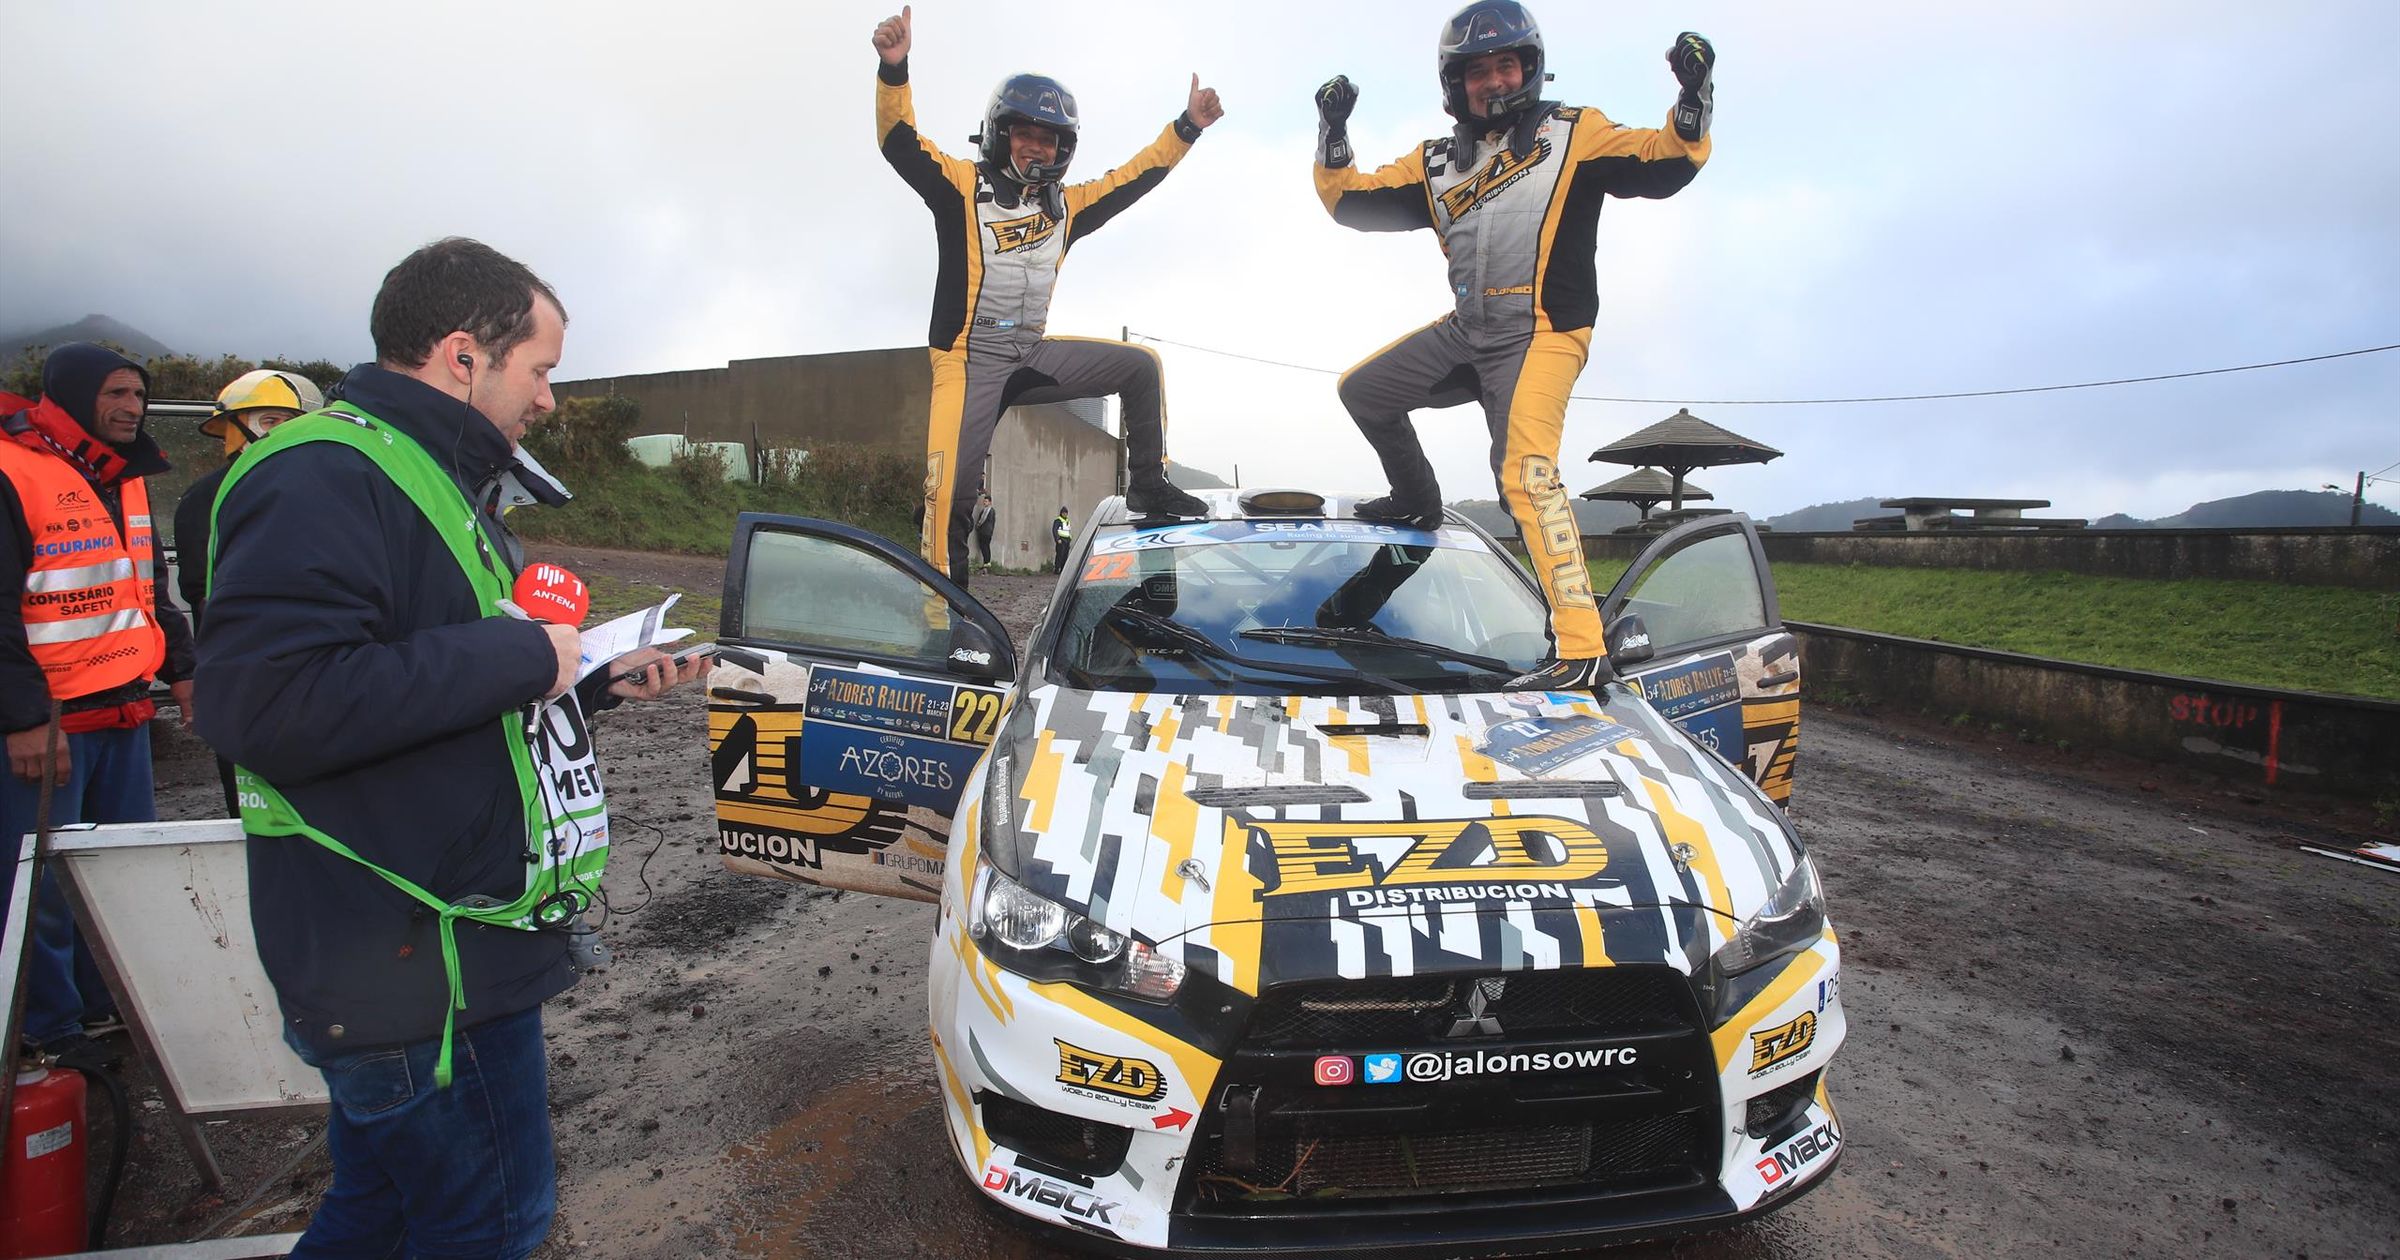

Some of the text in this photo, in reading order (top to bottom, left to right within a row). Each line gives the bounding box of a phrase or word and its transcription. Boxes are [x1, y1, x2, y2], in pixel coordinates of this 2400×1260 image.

[1468, 168, 1530, 213] DISTRIBUCION
[976, 318, 996, 326] OMP
[1254, 522, 1398, 535] SEAJETS
[1083, 553, 1135, 582] 22
[28, 586, 115, 606] COMISSÁRIO
[60, 599, 113, 616] SAFETY
[532, 589, 576, 612] ANTENA
[827, 678, 875, 706] AZORES
[877, 685, 926, 714] RALLYE
[927, 699, 949, 711] 21-23
[1659, 675, 1693, 702] AZORES
[1692, 667, 1724, 693] RALLYE
[952, 690, 1000, 744] 22
[1500, 721, 1552, 738] 22
[840, 746, 953, 790] AZORES
[1245, 815, 1609, 897] EZD
[1346, 883, 1569, 907] DISTRIBUCION
[1747, 1010, 1817, 1075] EZD
[1053, 1037, 1166, 1102] EZD
[1406, 1047, 1637, 1082] @jalonsowrc
